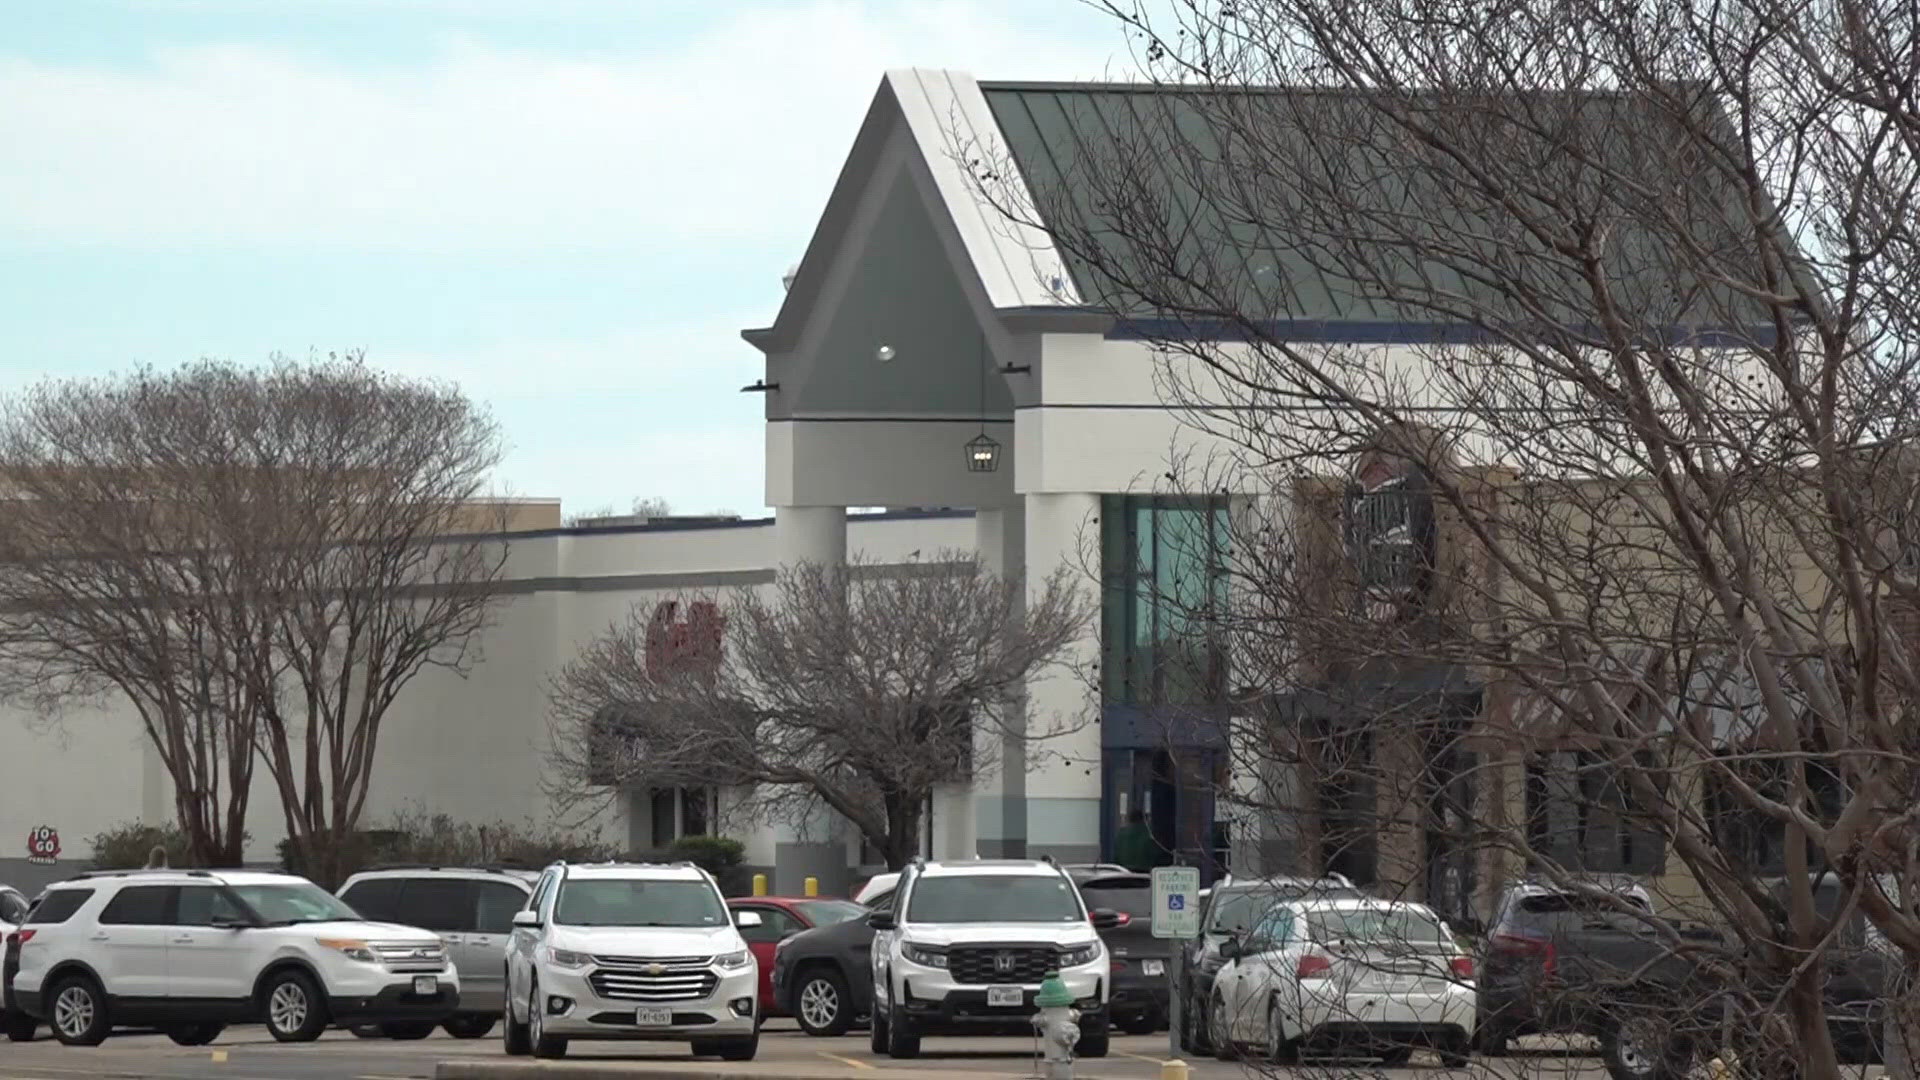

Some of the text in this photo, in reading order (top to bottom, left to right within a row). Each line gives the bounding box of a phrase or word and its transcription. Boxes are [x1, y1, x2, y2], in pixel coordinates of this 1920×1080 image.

[36, 841, 54, 852] GO
[1159, 873, 1194, 882] RESERVED
[1161, 883, 1192, 892] PARKING
